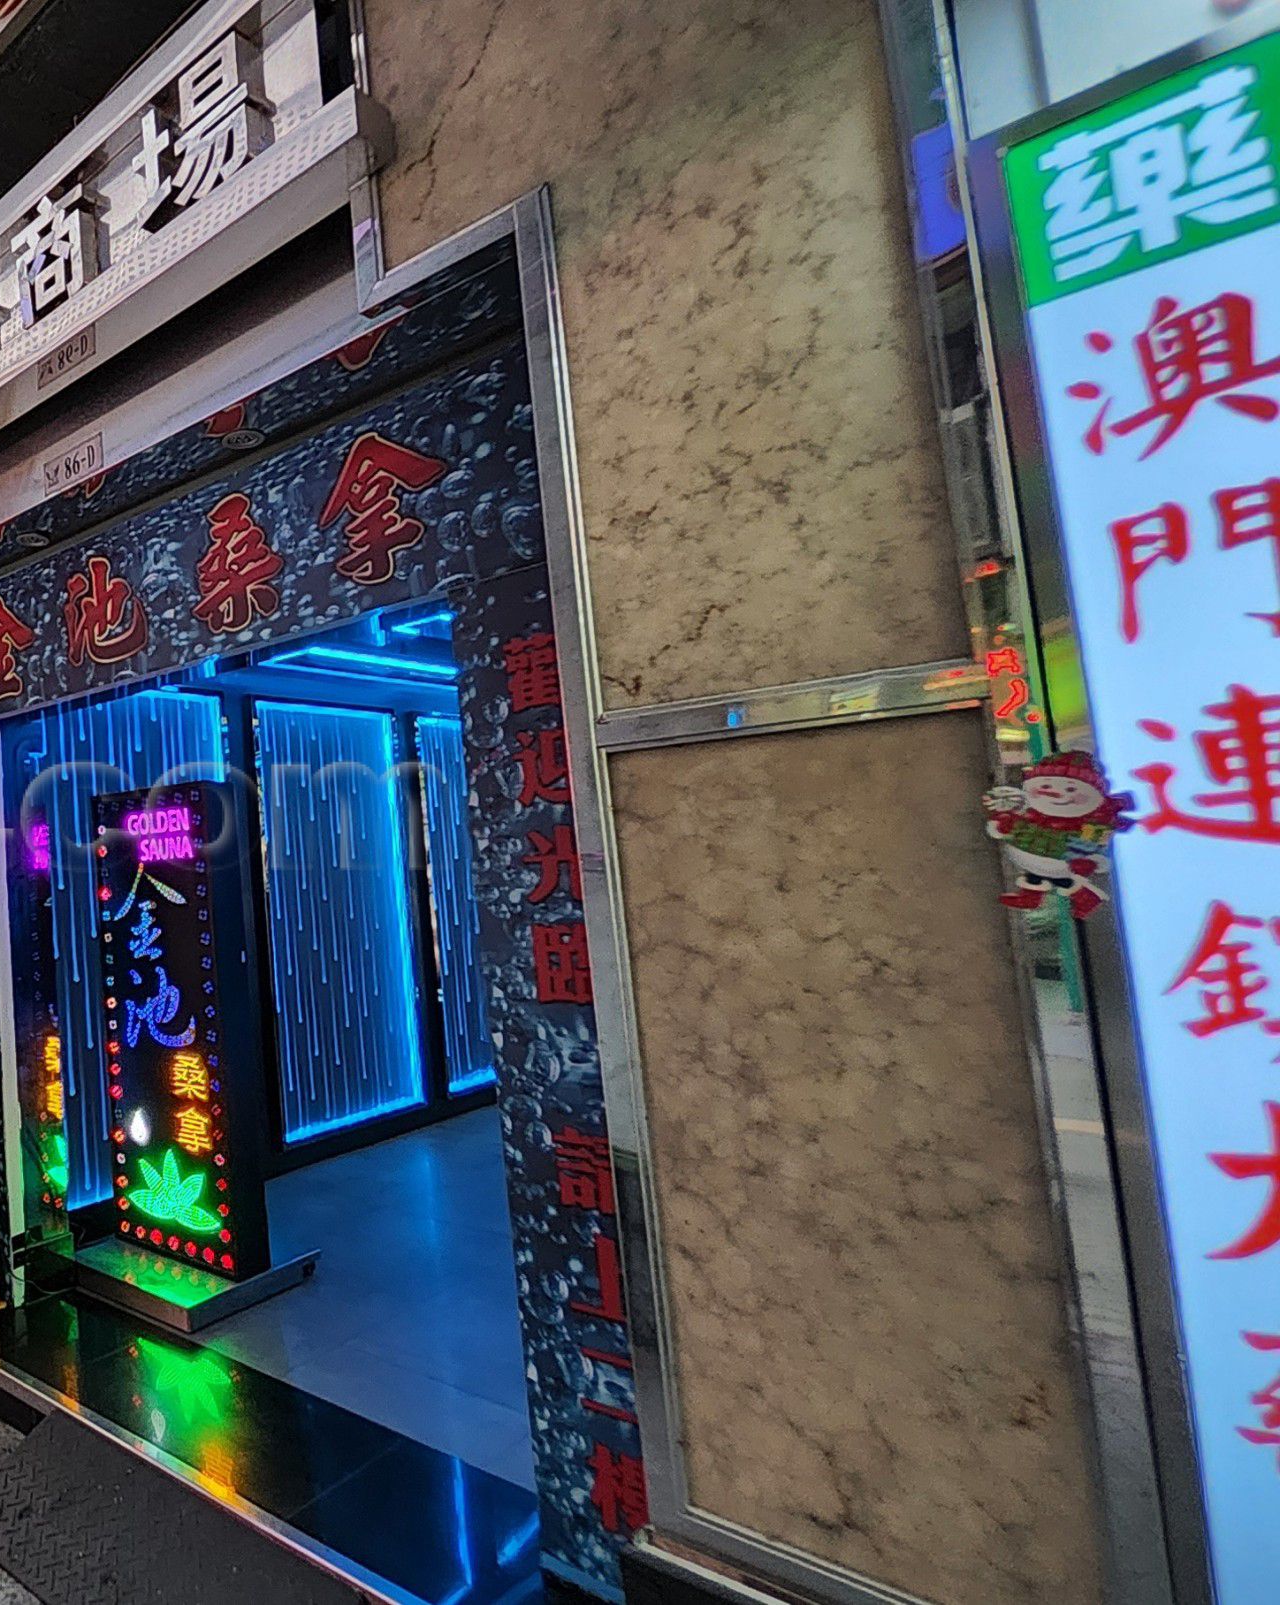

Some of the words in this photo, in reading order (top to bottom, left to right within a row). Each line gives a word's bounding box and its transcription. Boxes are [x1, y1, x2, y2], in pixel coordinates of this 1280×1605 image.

[1038, 64, 1280, 284] 藥
[64, 445, 95, 480] 86-D
[127, 806, 191, 836] GOLDEN
[139, 834, 194, 862] SAUNA
[114, 862, 196, 1048] 金池
